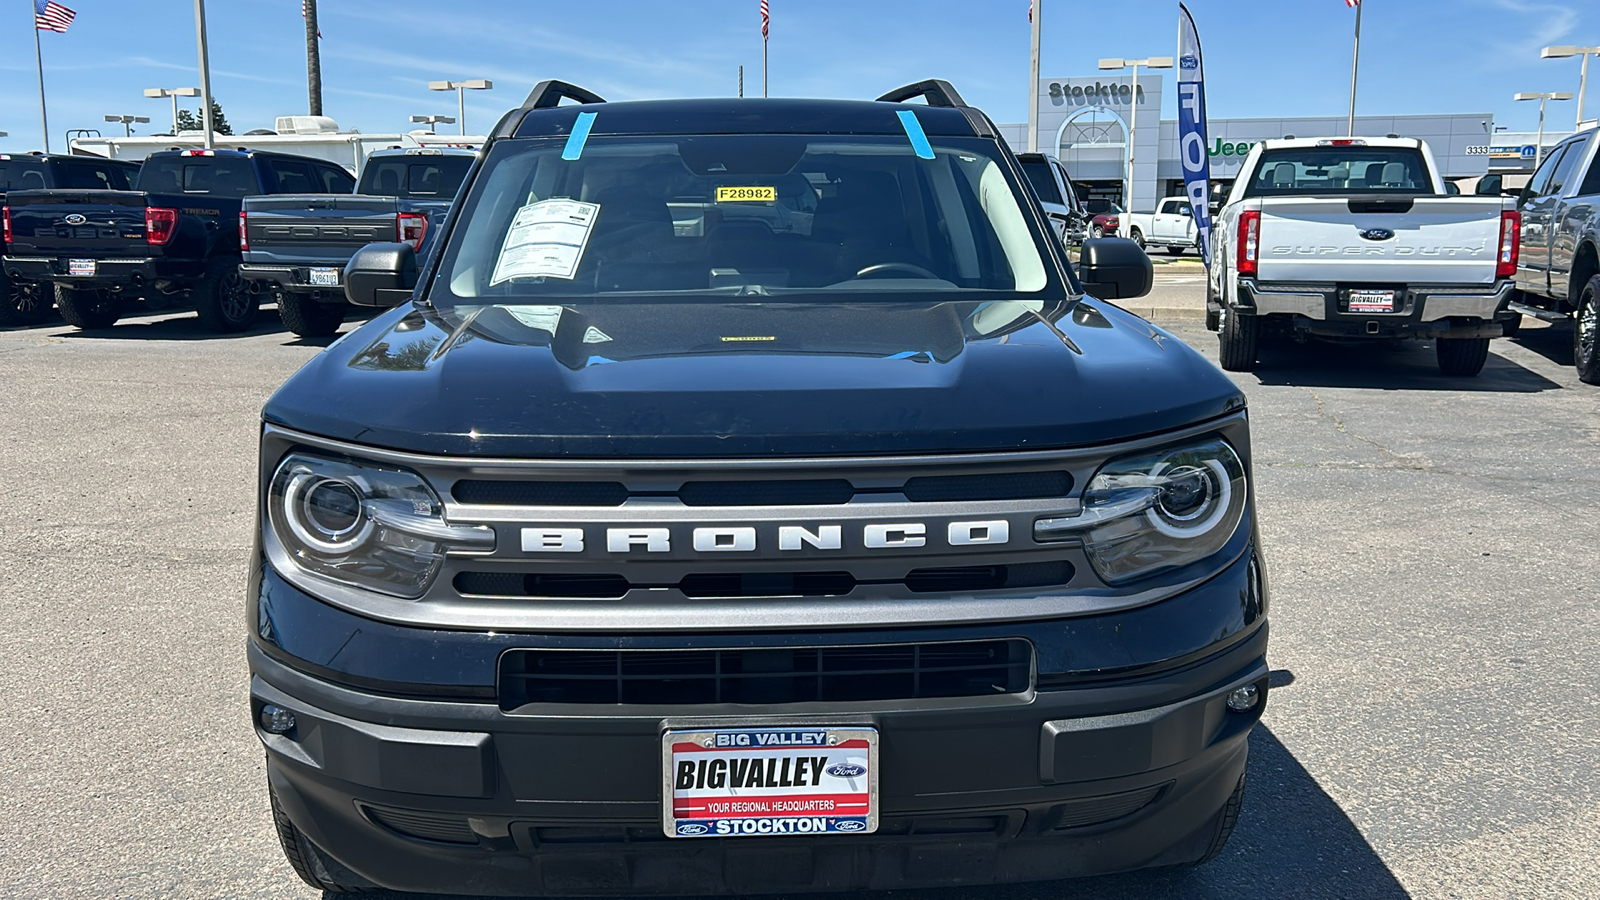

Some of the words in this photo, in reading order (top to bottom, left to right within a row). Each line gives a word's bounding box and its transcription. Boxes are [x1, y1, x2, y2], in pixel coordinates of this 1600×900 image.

[1048, 81, 1144, 98] Stockton
[1207, 137, 1256, 157] Jee
[1467, 146, 1489, 155] 3333
[720, 188, 772, 199] F28982
[263, 227, 378, 239] FORD
[1272, 245, 1390, 255] SUPER
[1395, 245, 1485, 256] DUTY
[520, 519, 1010, 553] BRONCO
[716, 733, 750, 747] BIG
[758, 732, 826, 746] VALLEY
[675, 756, 828, 790] BIGVALLEY
[707, 802, 730, 813] YOUR
[731, 801, 771, 813] REGIONAL
[772, 799, 835, 812] HEADQUARTERS
[716, 817, 827, 834] STOCKTON
